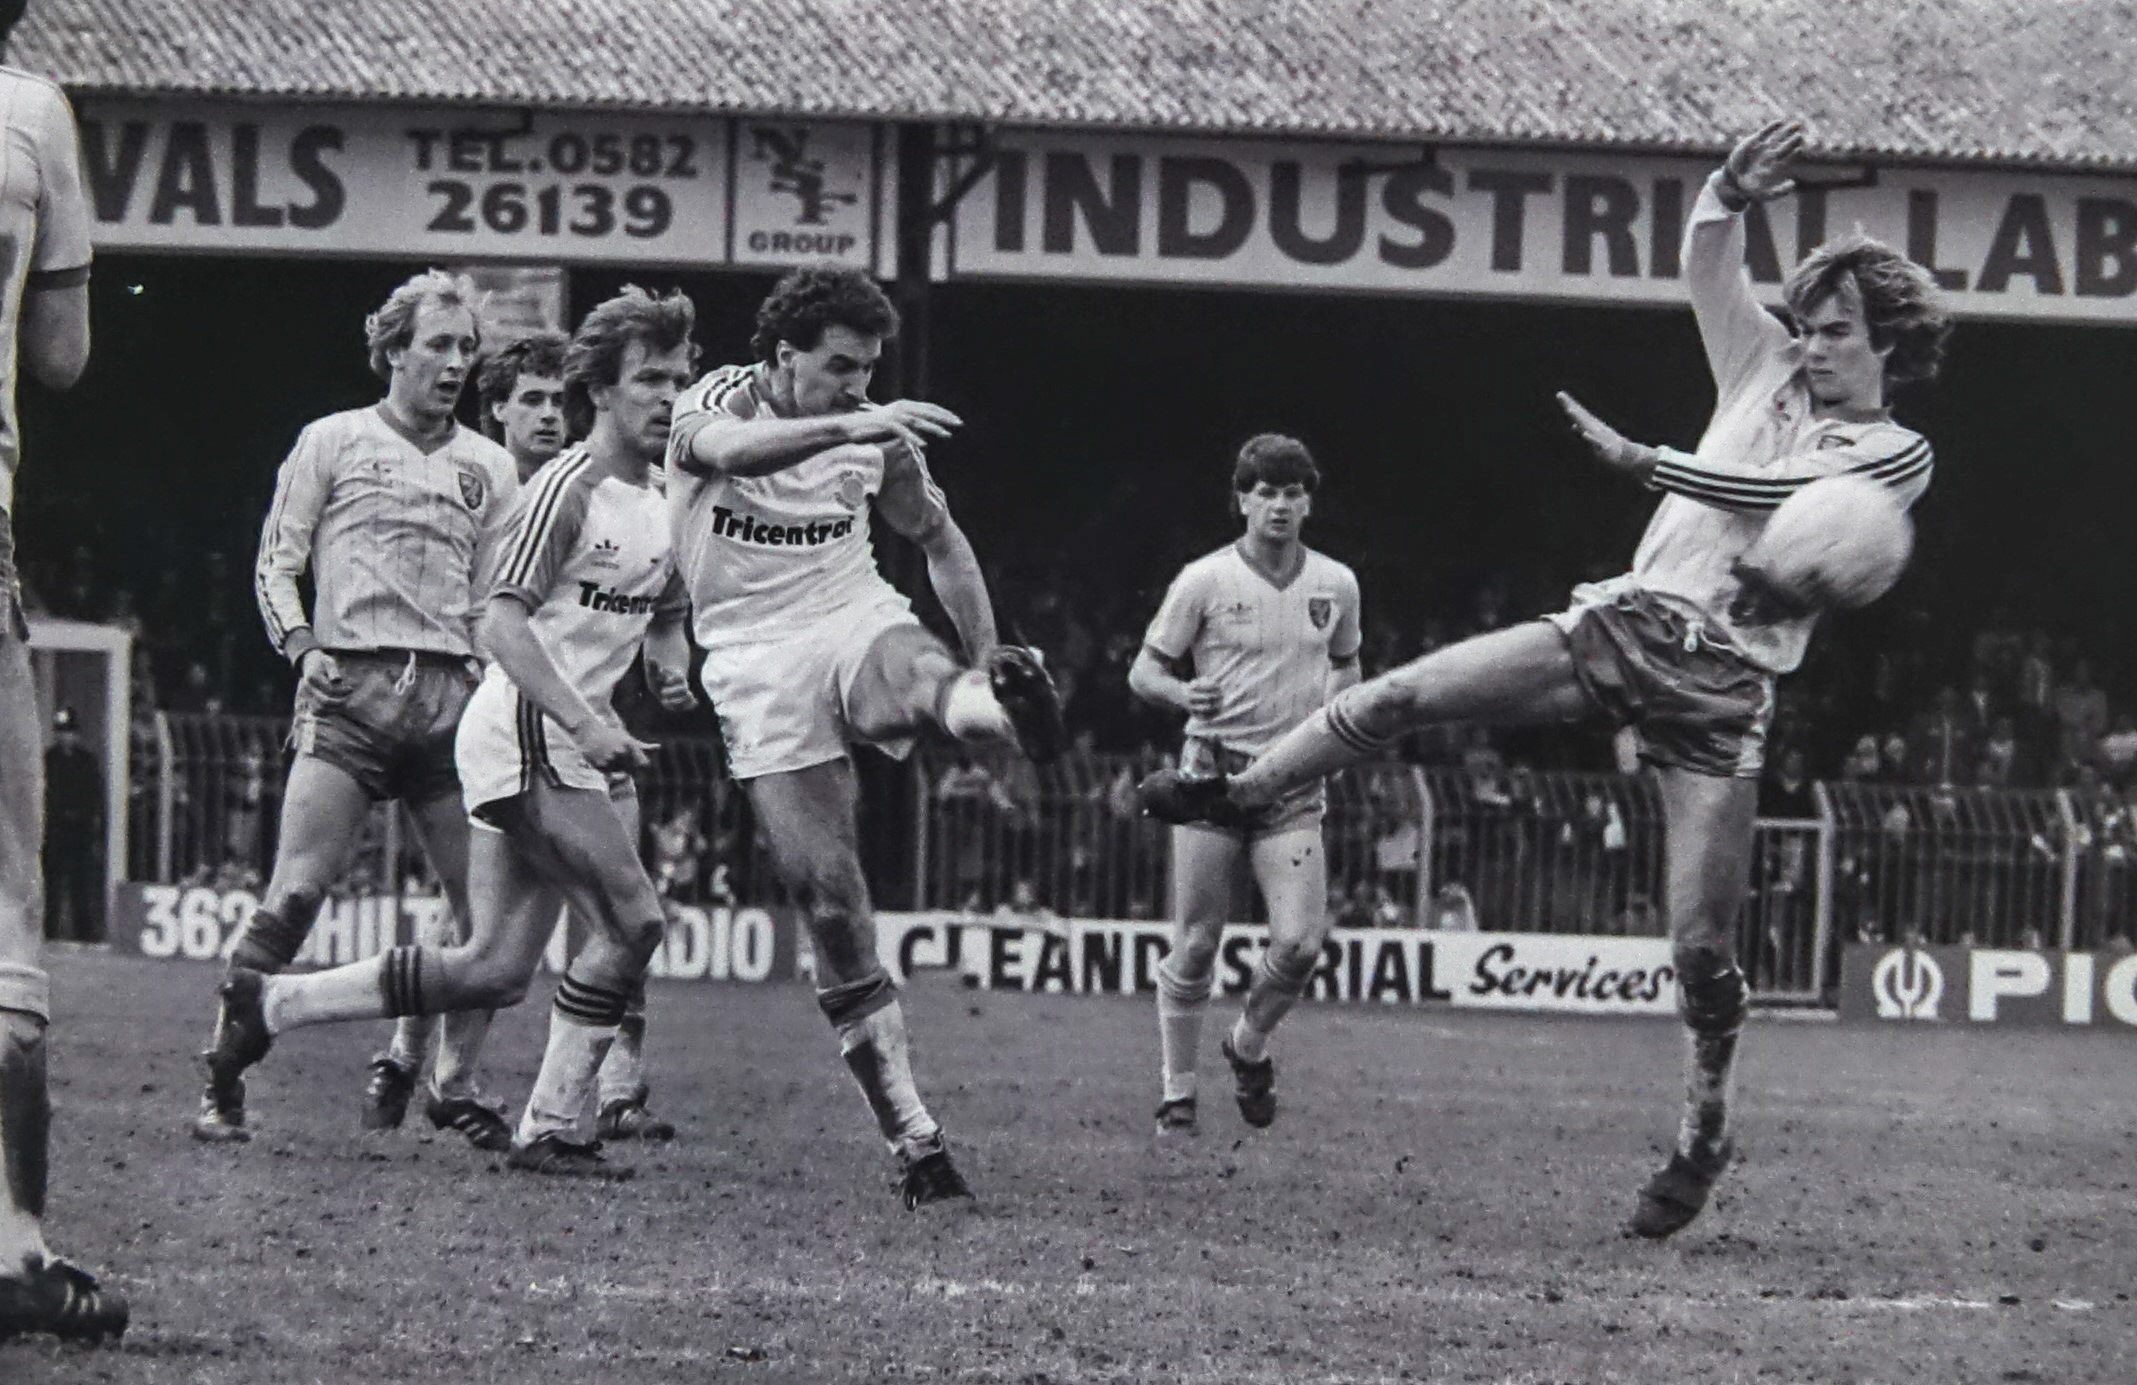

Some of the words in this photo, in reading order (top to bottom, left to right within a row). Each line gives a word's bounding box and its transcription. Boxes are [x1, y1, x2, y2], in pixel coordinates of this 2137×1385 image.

[80, 119, 344, 229] VALS
[405, 129, 697, 178] TEL.0582
[426, 179, 673, 238] 26139
[749, 230, 855, 256] GROUP
[1907, 189, 2137, 297] LAB
[141, 886, 257, 959] 362
[647, 904, 775, 982] DIO
[1468, 942, 1675, 1001] Services
